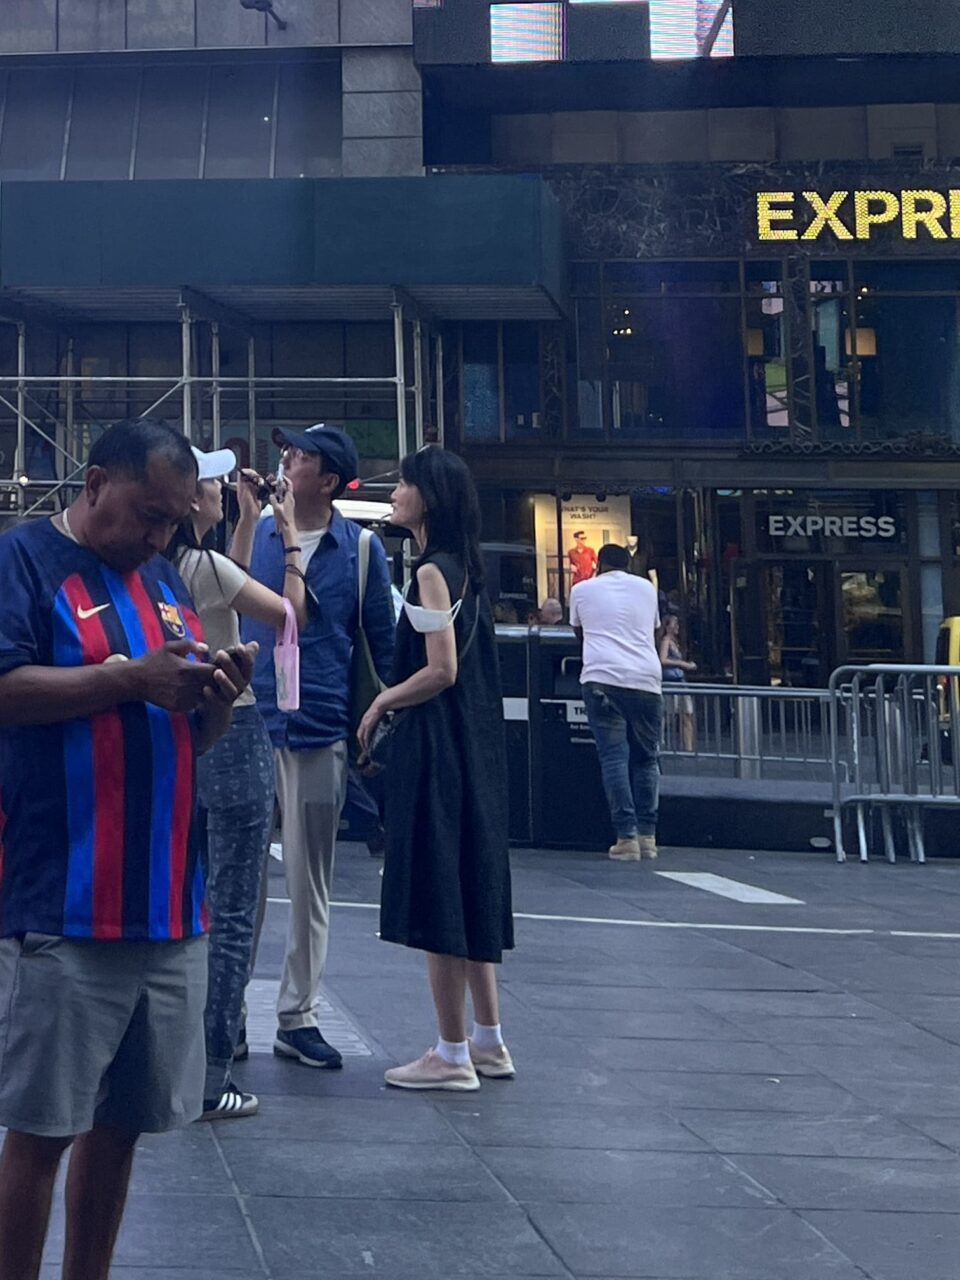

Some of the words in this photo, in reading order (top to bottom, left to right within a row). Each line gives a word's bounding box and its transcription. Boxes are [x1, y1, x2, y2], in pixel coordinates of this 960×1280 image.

[757, 190, 960, 240] EXPR
[562, 505, 586, 513] HAT'S
[768, 515, 896, 537] EXPRESS
